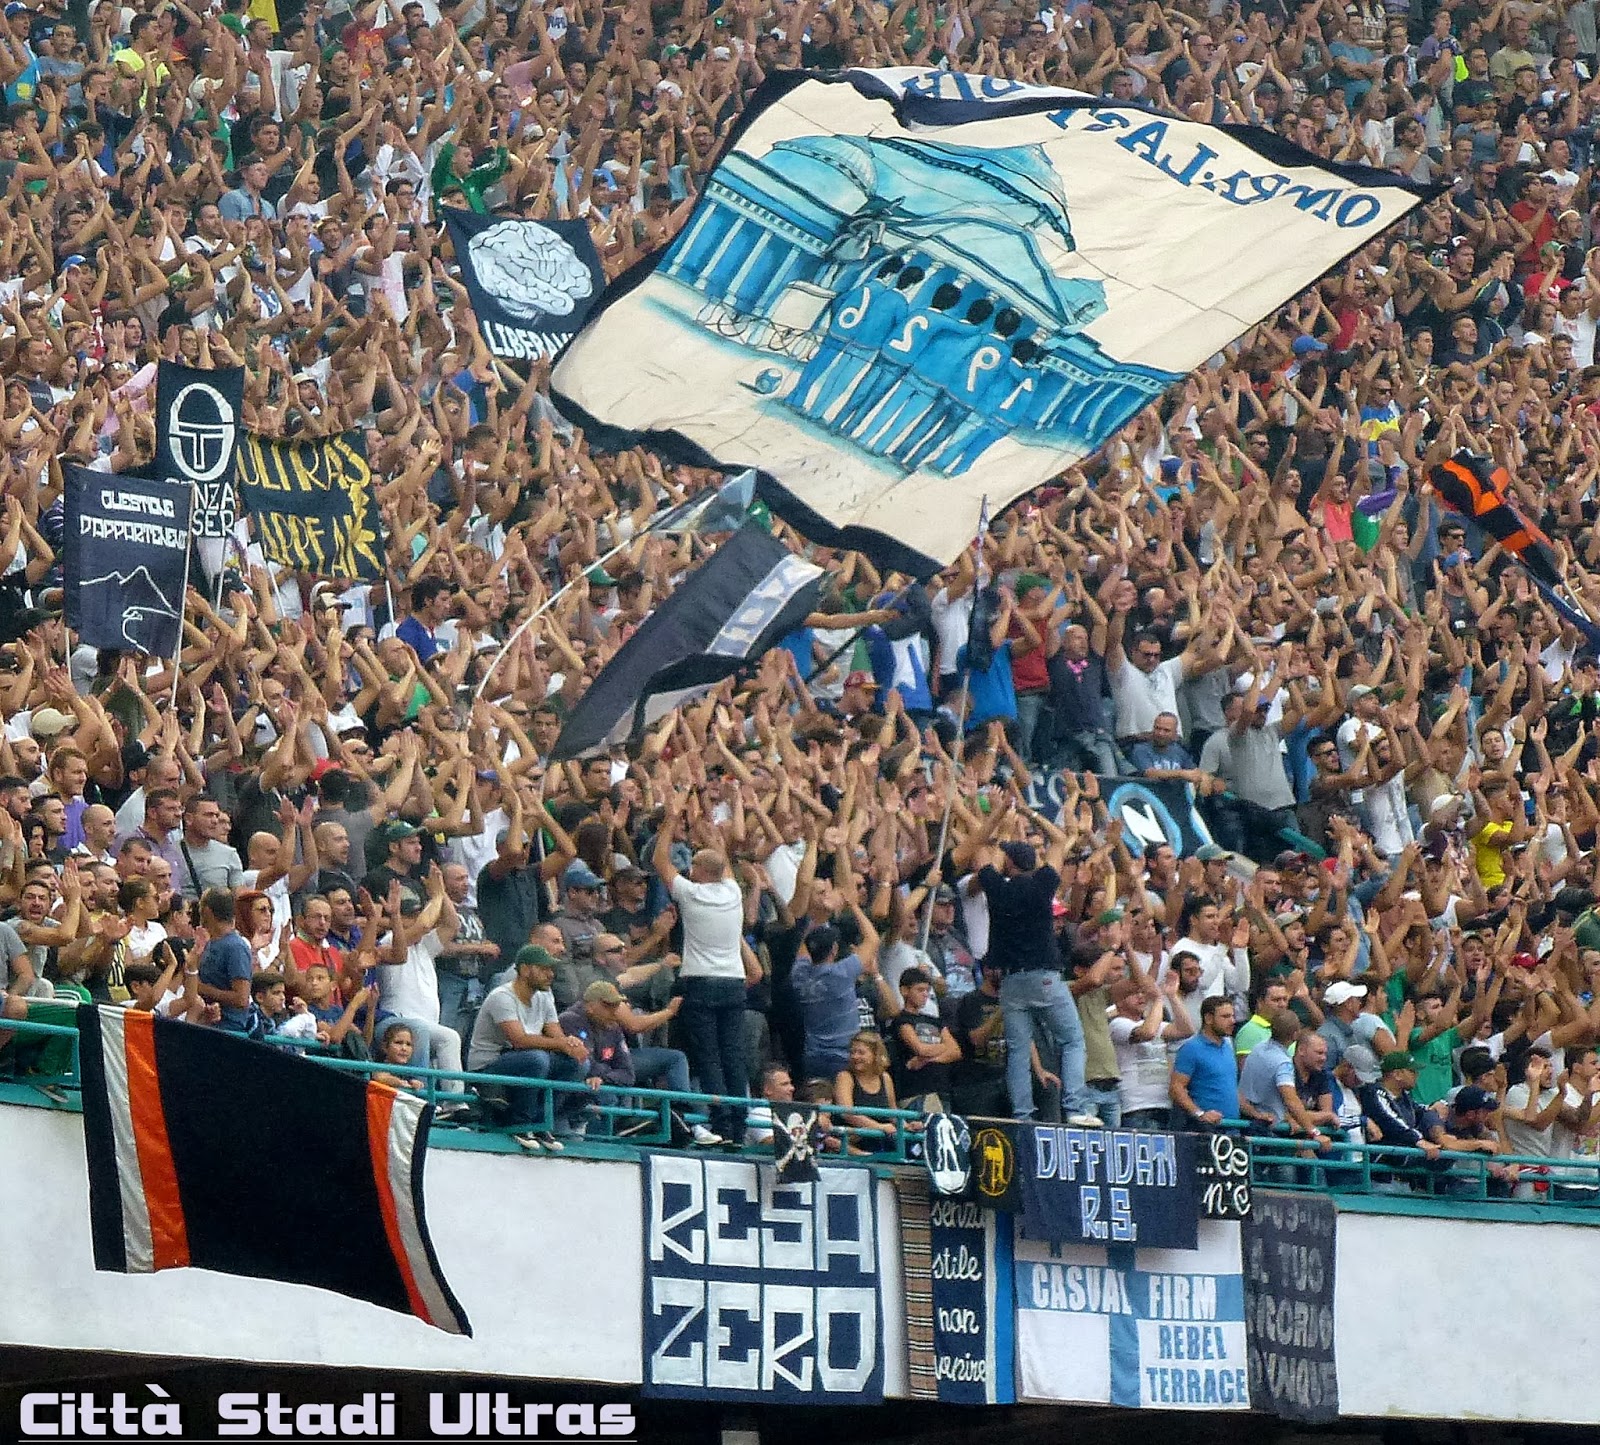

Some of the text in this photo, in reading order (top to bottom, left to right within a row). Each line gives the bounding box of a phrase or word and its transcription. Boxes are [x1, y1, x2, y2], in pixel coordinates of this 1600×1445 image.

[236, 434, 371, 491] ULTRAS
[101, 490, 175, 518] QUESTIONE
[650, 1154, 876, 1274] RESA
[1080, 1185, 1137, 1242] R.S.
[932, 1244, 982, 1281] stile
[1031, 1263, 1217, 1320] CASUAL FIRM
[651, 1276, 877, 1392] ZERO
[938, 1307, 980, 1334] non
[1158, 1324, 1228, 1360] REBEL
[1145, 1366, 1249, 1404] TERRACE
